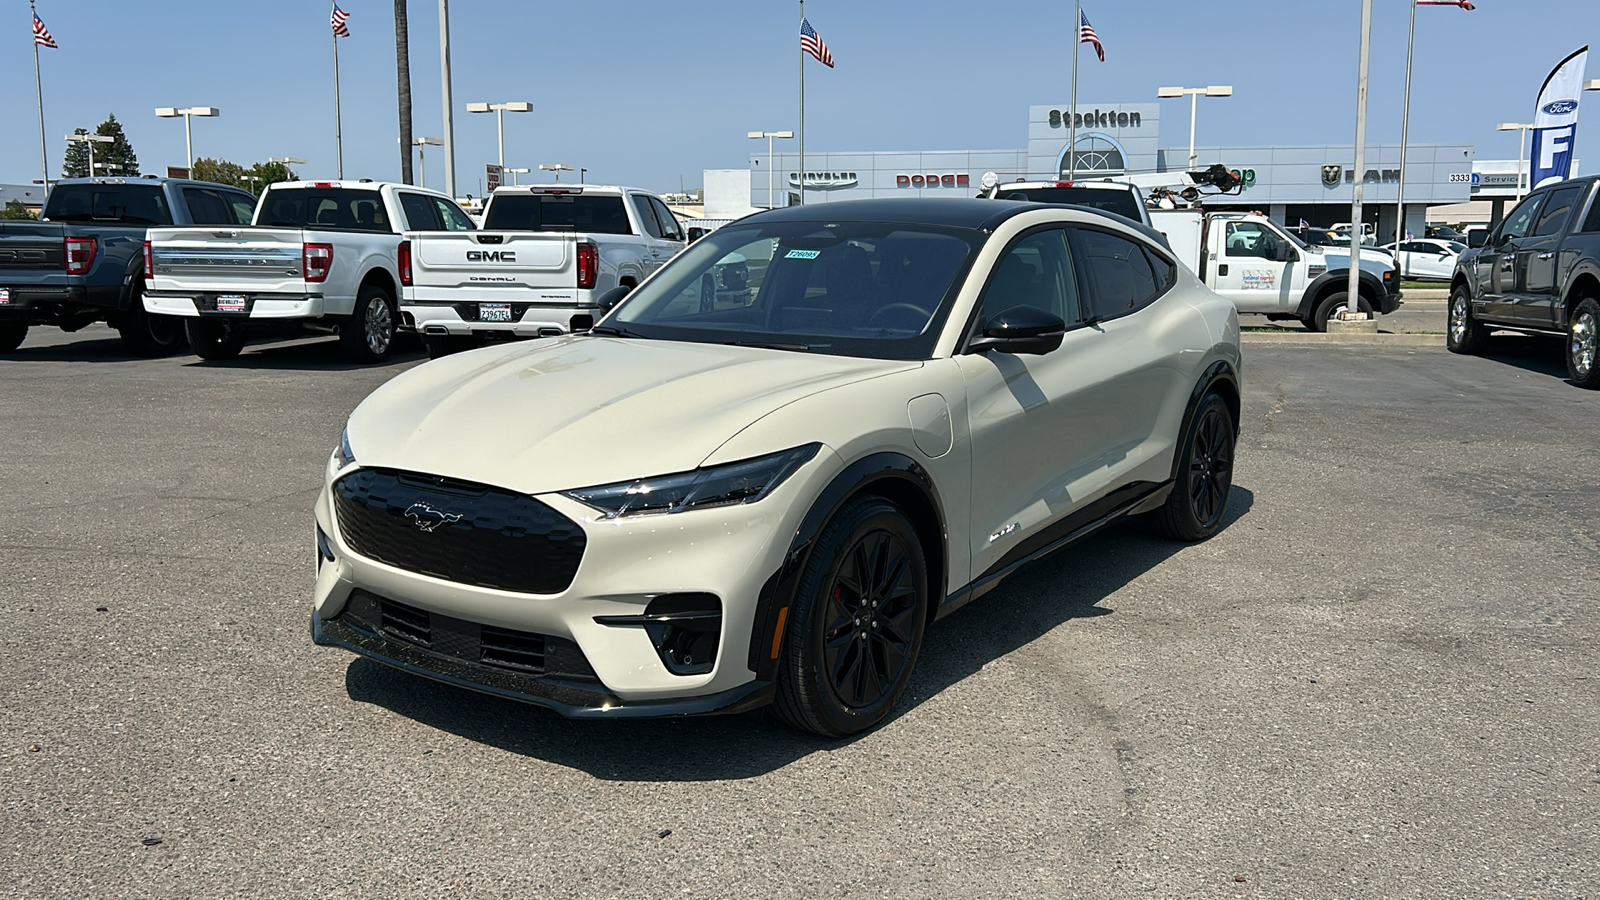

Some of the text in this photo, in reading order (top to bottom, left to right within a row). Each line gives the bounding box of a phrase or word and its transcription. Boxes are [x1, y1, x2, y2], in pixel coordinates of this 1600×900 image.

[1048, 108, 1141, 129] Stockton
[790, 172, 857, 181] CHRYSLER
[896, 174, 970, 188] DODGE
[1450, 174, 1470, 182] 3333
[466, 250, 516, 262] GMC
[481, 310, 510, 319] 23967E4
